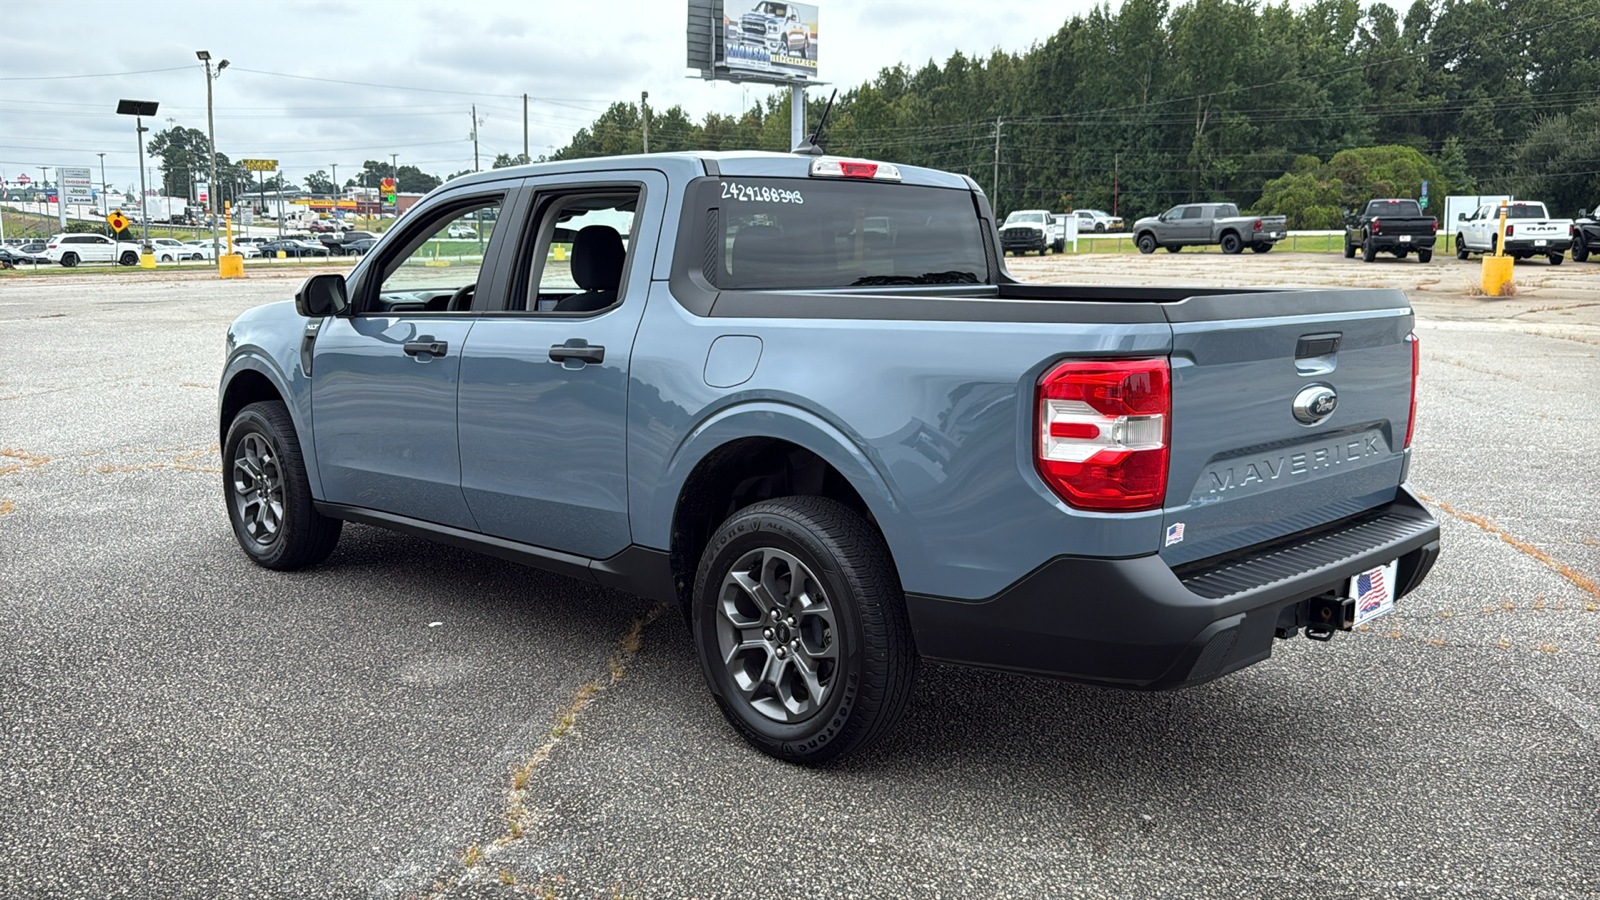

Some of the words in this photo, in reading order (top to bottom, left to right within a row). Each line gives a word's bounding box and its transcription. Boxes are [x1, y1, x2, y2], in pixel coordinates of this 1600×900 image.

[726, 43, 771, 63] THOMSON
[771, 54, 817, 68] JEEPCHEAP.COM
[1316, 395, 1335, 413] Ford
[1209, 436, 1379, 493] MAVERICK
[766, 521, 784, 532] ALL
